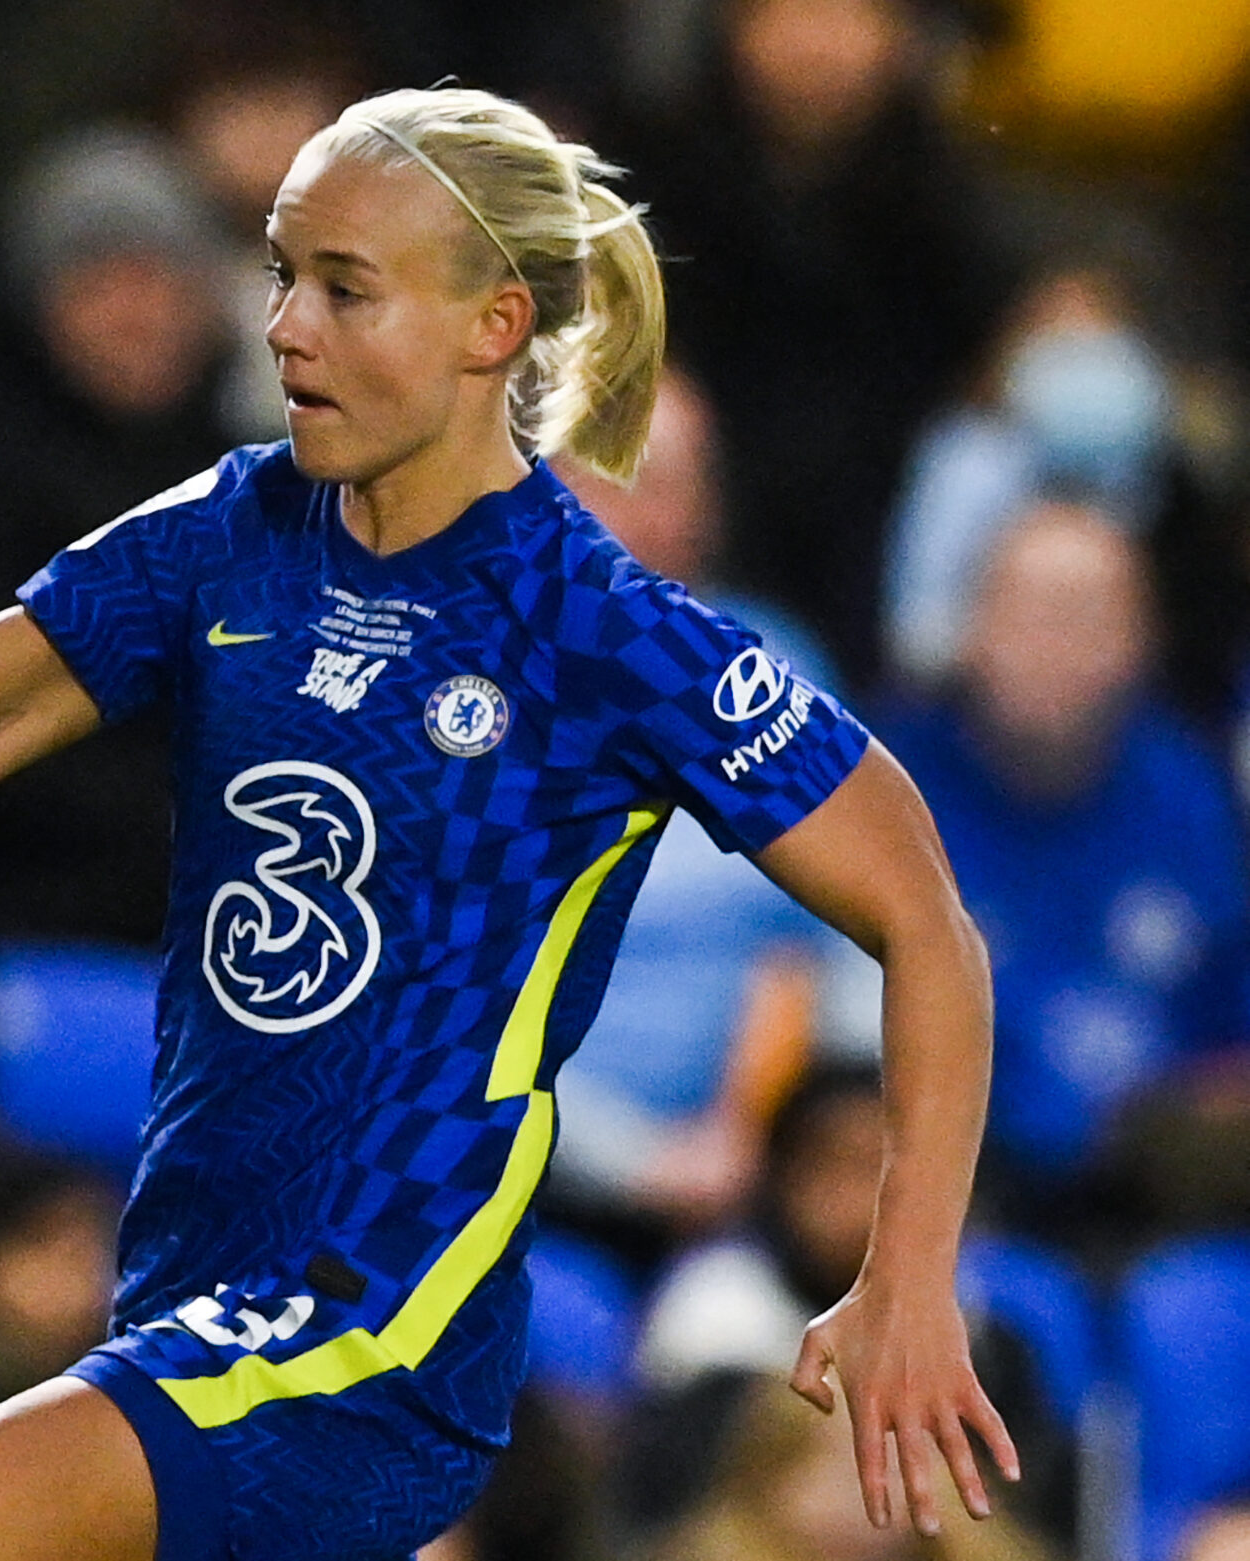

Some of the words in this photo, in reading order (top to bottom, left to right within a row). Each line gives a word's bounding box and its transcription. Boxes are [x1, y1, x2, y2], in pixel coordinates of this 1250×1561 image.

[311, 648, 366, 678] TAKE
[359, 659, 388, 684] A
[720, 680, 815, 782] HYUNDAI
